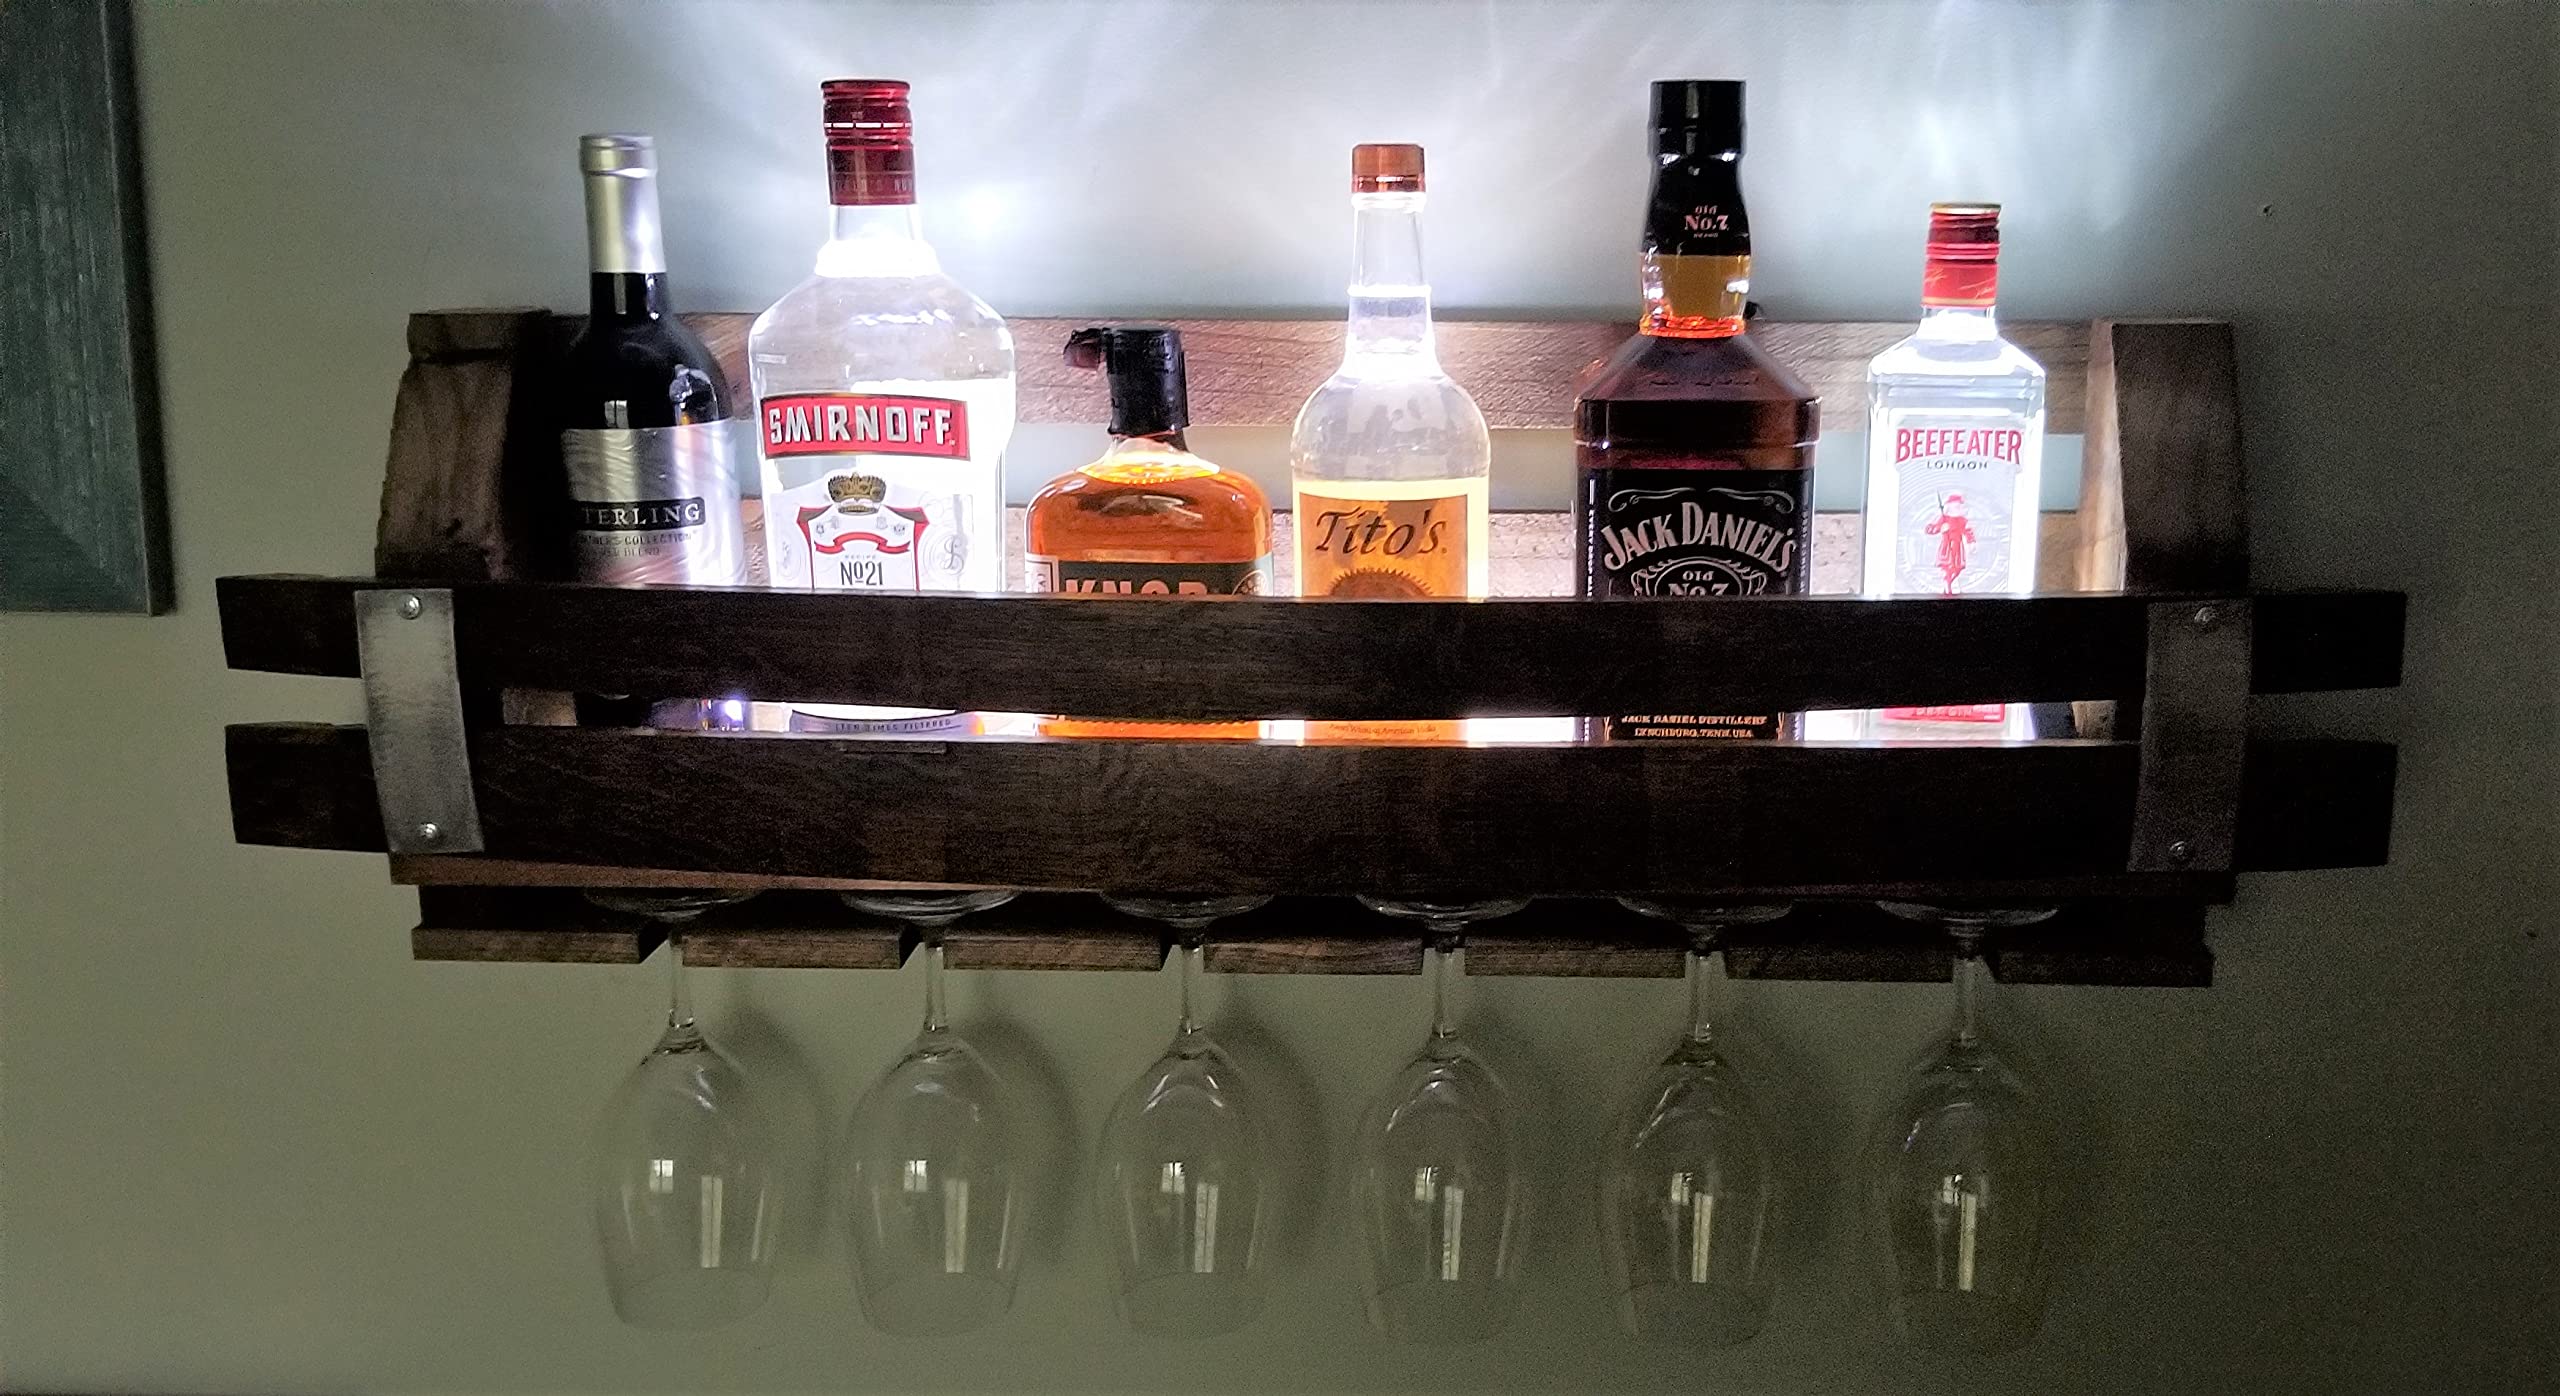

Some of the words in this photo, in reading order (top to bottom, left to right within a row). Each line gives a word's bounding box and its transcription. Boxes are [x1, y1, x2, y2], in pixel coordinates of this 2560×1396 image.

[769, 404, 953, 446] SMIRNOFF
[1895, 428, 2023, 465] BEEFEATER
[1926, 459, 1988, 470] LONDON
[582, 503, 701, 526] TERLING
[1315, 506, 1446, 555] Tito's
[1600, 513, 1679, 571] JACK
[1681, 501, 1797, 573] DANIEL'S
[1621, 714, 1650, 724] JACK
[1698, 715, 1768, 726] DISTILLERY
